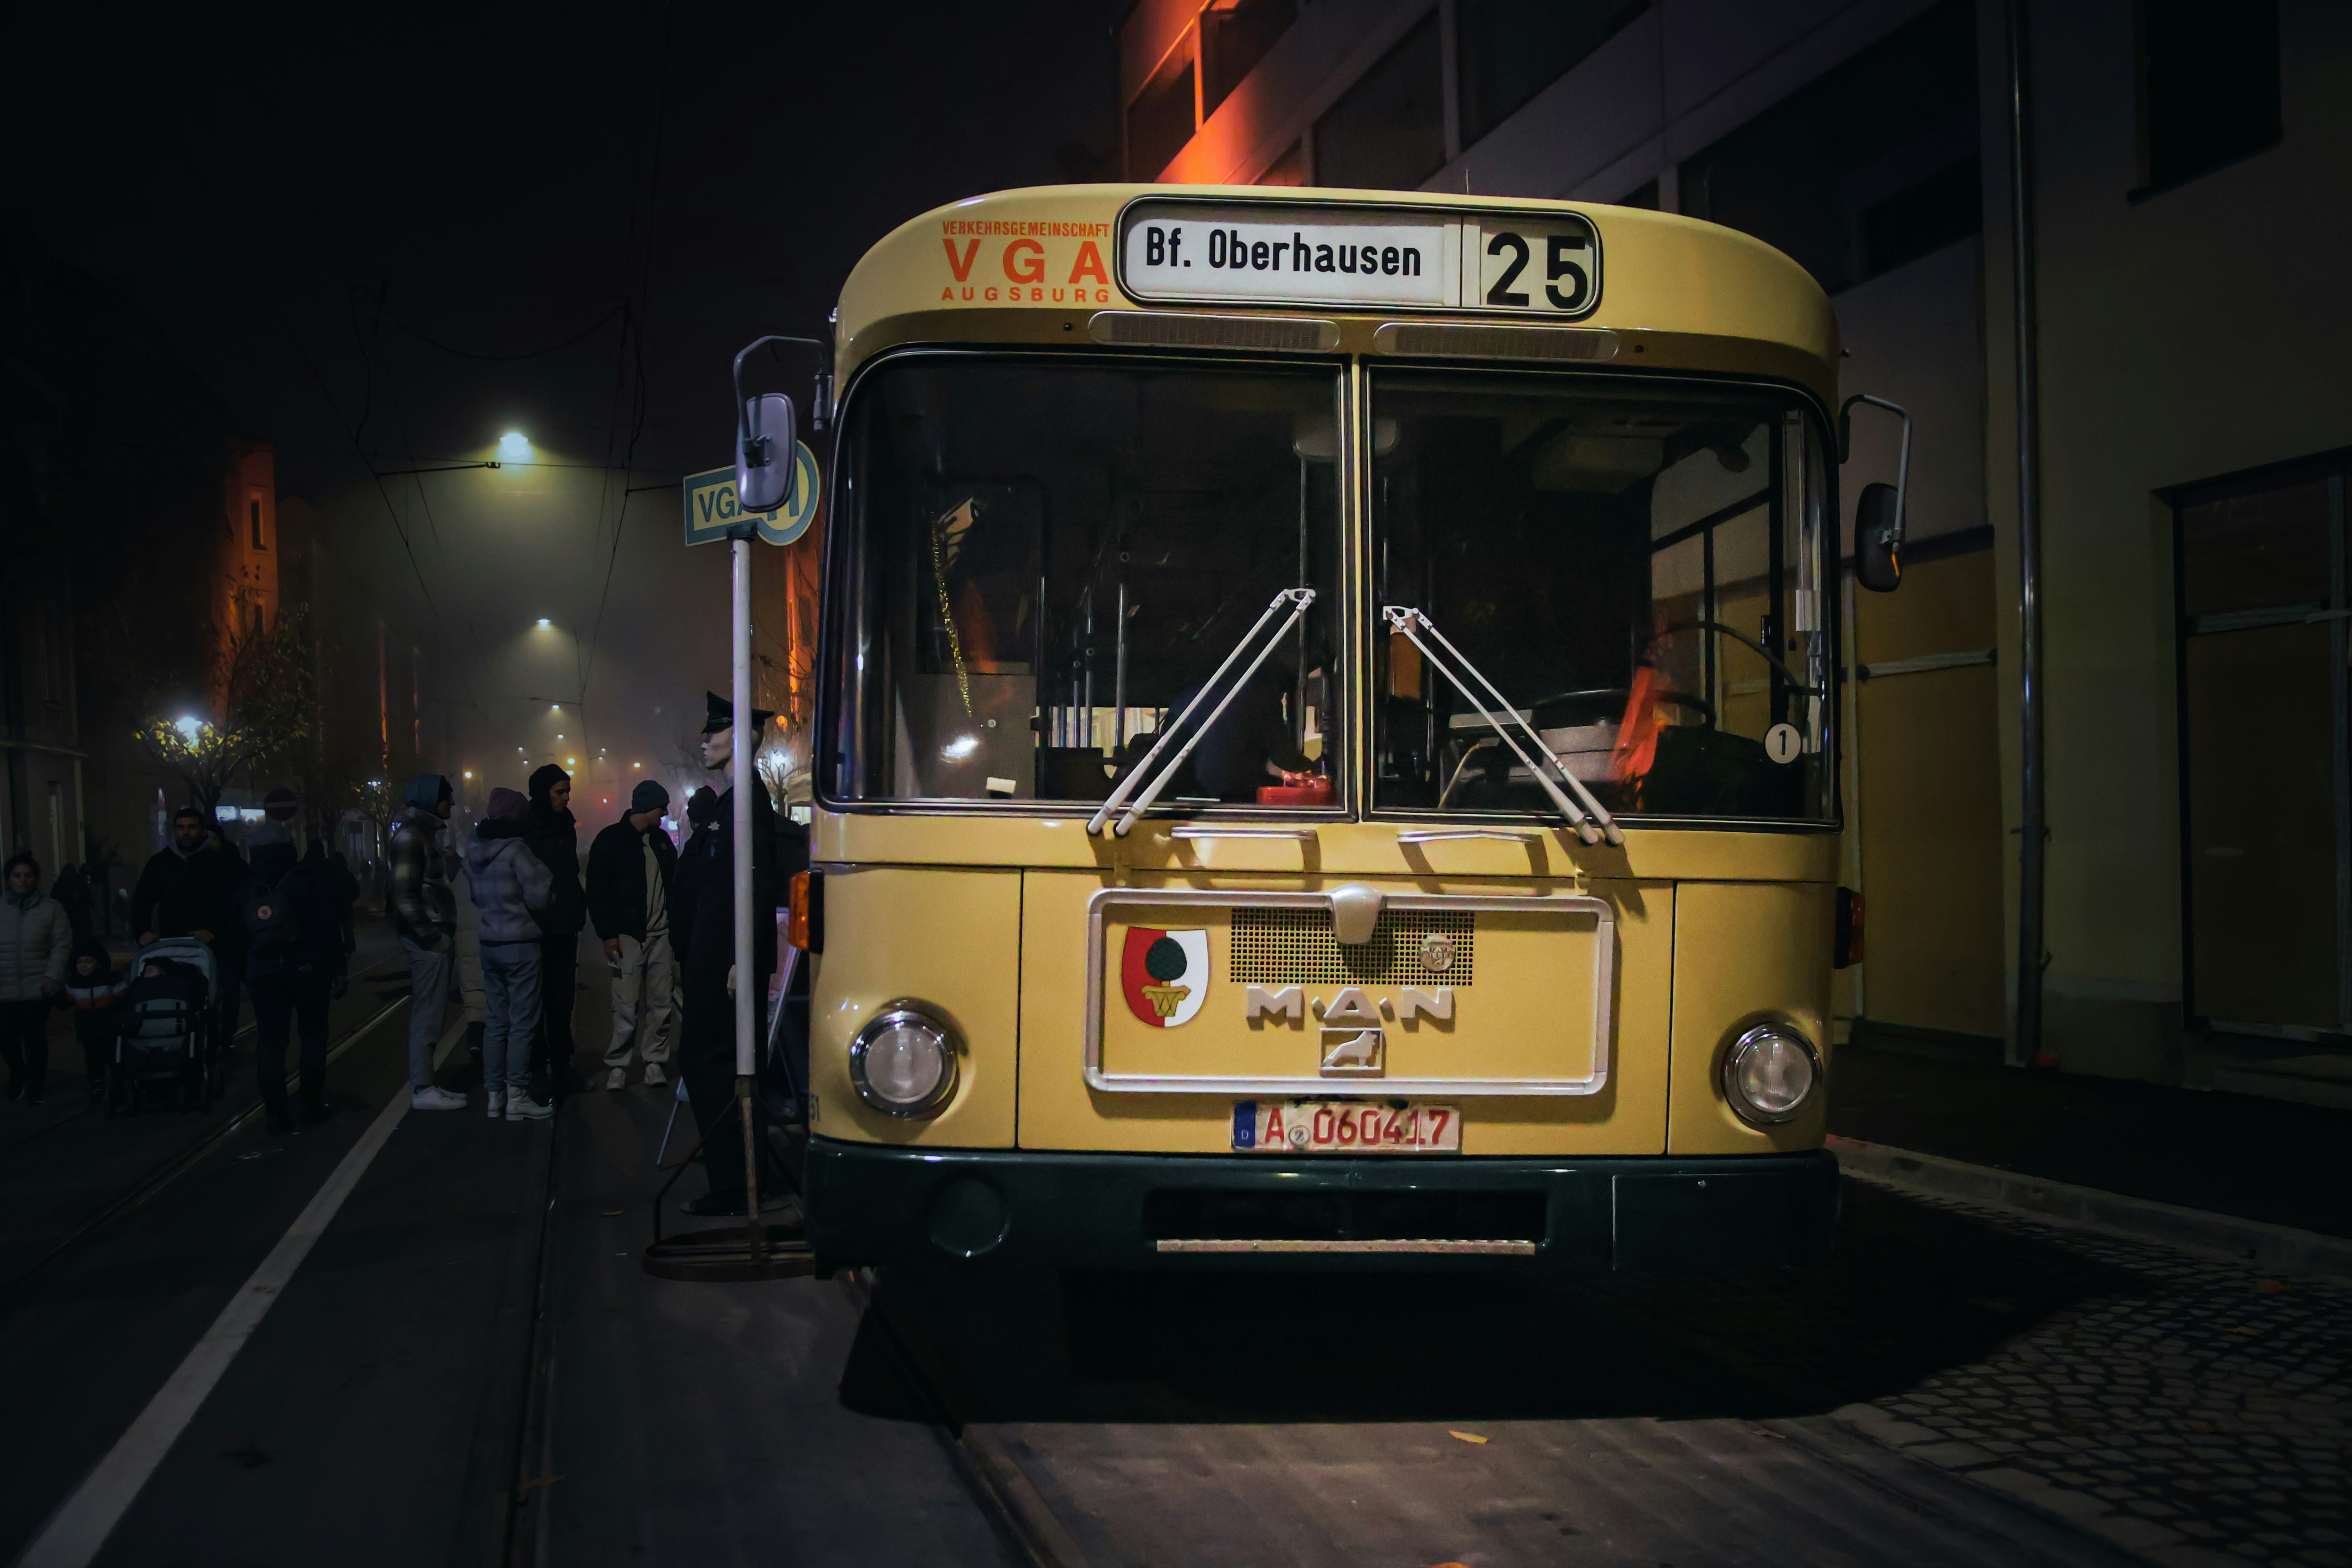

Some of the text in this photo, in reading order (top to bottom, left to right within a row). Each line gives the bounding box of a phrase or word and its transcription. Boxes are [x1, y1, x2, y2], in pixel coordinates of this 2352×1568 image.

[942, 221, 1110, 237] VERKEHRSGEMEINSCHAFT
[943, 238, 1109, 285] VGA
[1146, 227, 1421, 276] Bf. Oberhausen
[1487, 232, 1587, 309] 25
[942, 287, 1109, 303] AUGSBURG
[698, 486, 743, 523] VG
[1779, 730, 1786, 755] 1
[1265, 1107, 1284, 1143] A
[1313, 1108, 1449, 1145] 060417
